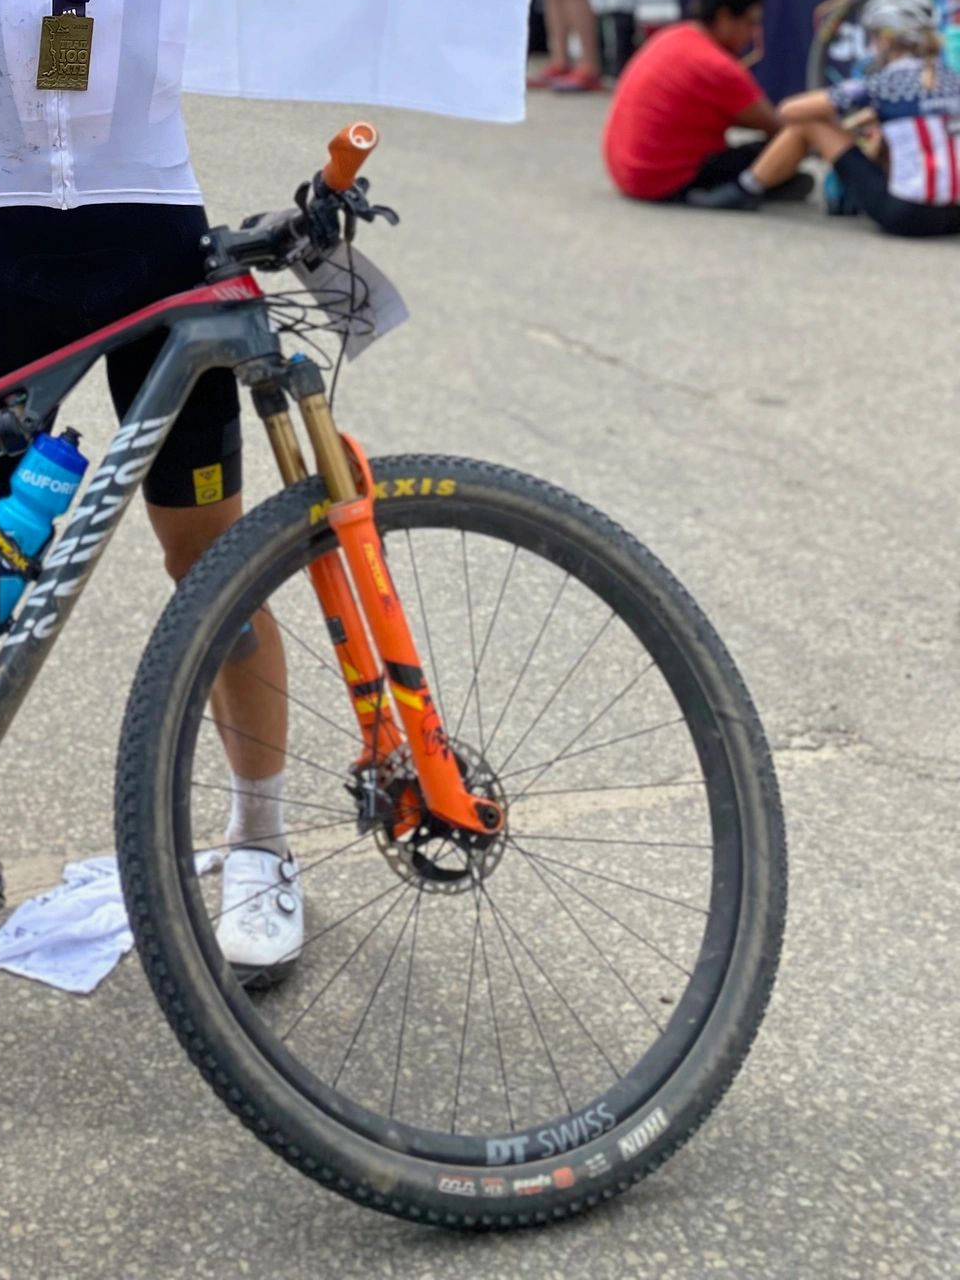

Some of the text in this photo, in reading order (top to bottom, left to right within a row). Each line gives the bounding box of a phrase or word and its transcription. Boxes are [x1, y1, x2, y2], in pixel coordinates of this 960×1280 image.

[59, 49, 89, 62] 100
[309, 477, 456, 526] MXXIS
[486, 1101, 617, 1166] DT SWISS
